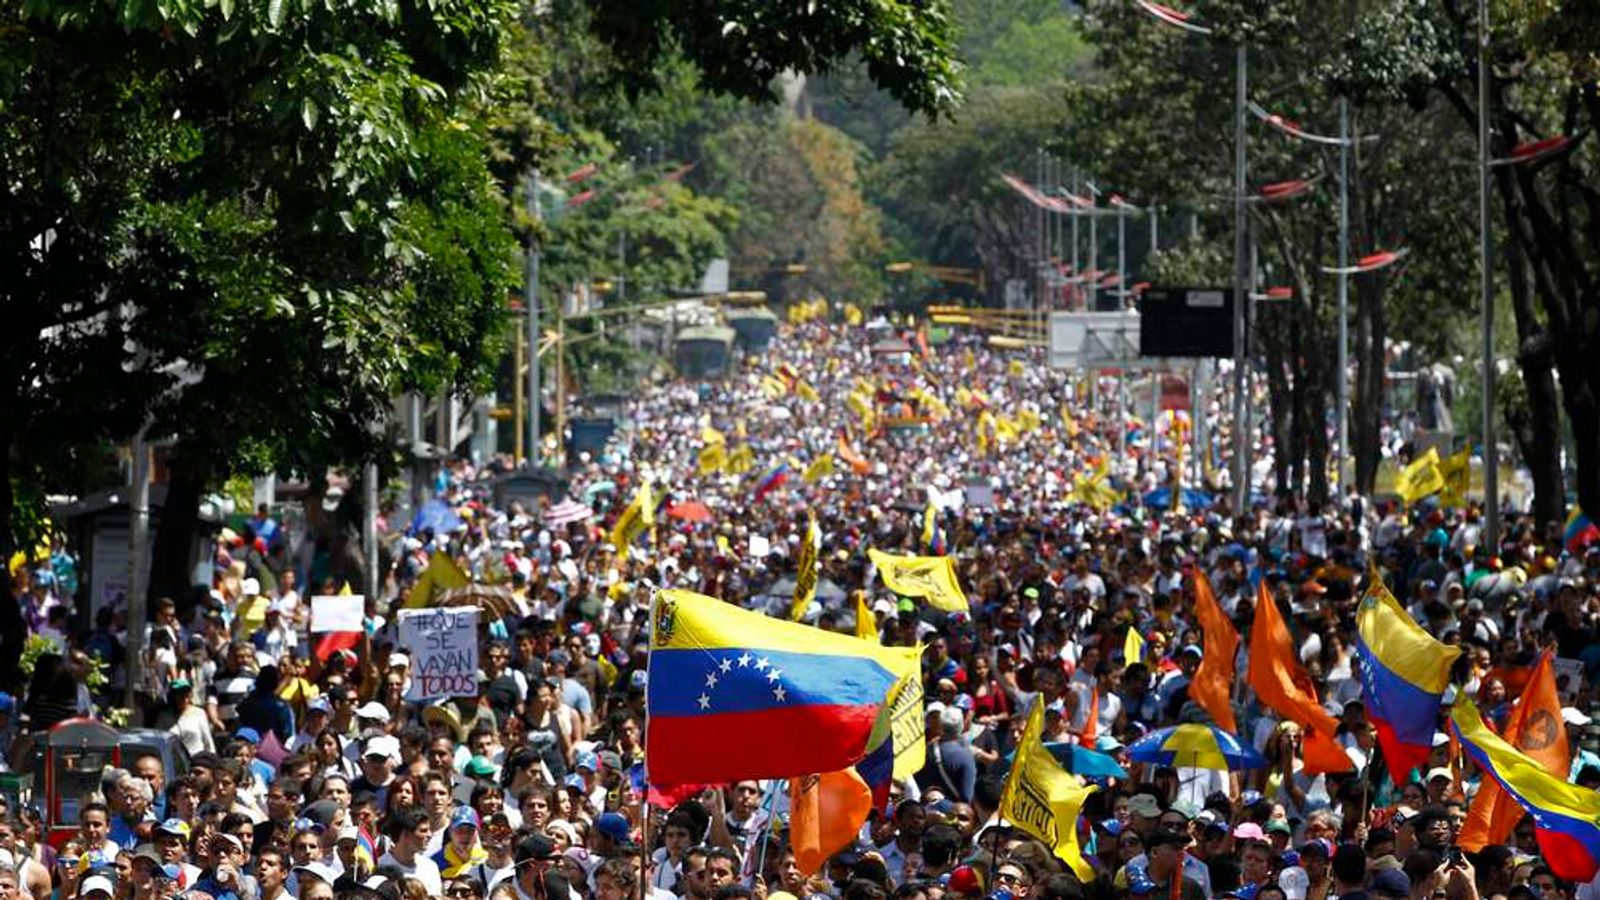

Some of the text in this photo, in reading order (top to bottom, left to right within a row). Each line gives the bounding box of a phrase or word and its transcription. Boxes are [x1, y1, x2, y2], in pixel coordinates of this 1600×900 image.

[426, 631, 457, 650] SE
[417, 649, 473, 675] VAYAN
[416, 674, 475, 696] TODOS
